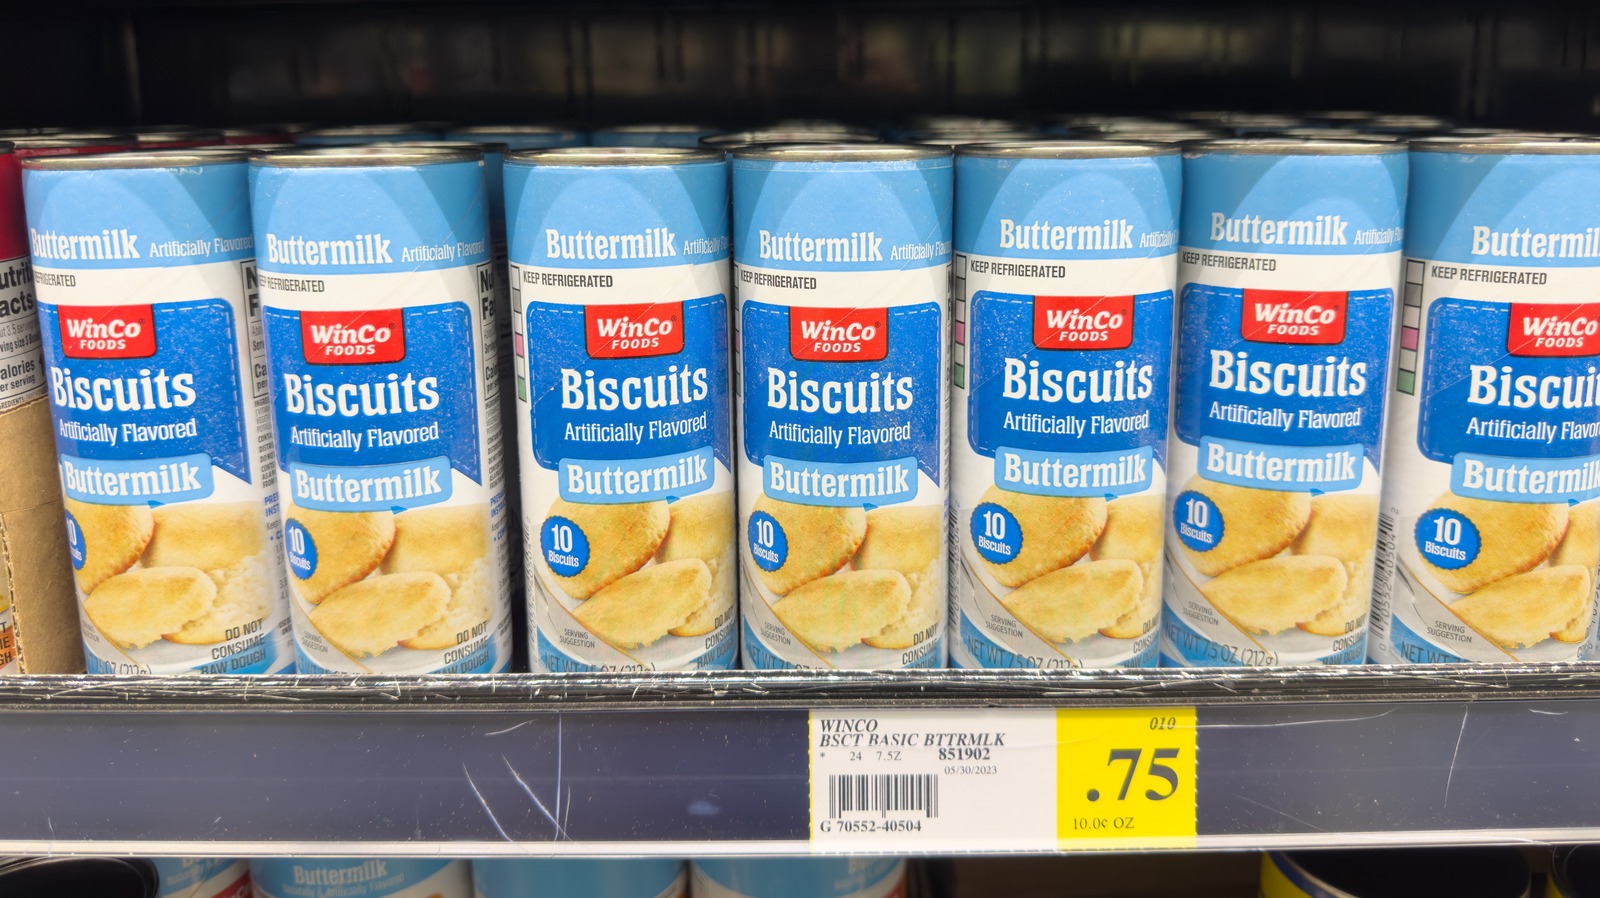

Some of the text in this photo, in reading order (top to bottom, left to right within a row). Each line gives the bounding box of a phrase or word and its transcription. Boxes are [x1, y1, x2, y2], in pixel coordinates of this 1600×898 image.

[1000, 219, 1134, 250] Buttermilk
[1139, 231, 1173, 248] Artificially
[1210, 212, 1348, 245] Buttermilk
[1354, 228, 1394, 246] Artificially
[31, 228, 253, 260] Buttermilk Artificially Flavored
[266, 233, 392, 266] Buttermilk
[401, 245, 455, 264] Artificially
[546, 227, 677, 260] Buttermilk
[683, 238, 720, 255] Artificially
[759, 230, 883, 263] Buttermilk
[890, 243, 934, 260] Artificially
[1471, 226, 1600, 259] Buttermil
[971, 260, 1066, 278] KEEP REFRIGERATED
[1182, 251, 1276, 271] KEEP REFRIGERATED
[267, 276, 325, 292] REFRIGERATED
[523, 271, 613, 288] KEEP REFRIGERATED
[740, 269, 817, 290] KEEP REFRIGERATED
[1431, 265, 1548, 285] KEEP REFRIGERATED
[0, 291, 34, 318] acts
[1255, 303, 1335, 324] WinCo
[67, 319, 141, 339] WinCo
[597, 316, 673, 339] WinCo
[1046, 309, 1123, 329] WinCo
[1522, 316, 1598, 337] WinCo
[311, 324, 391, 344] WinCo
[801, 320, 876, 341] WinCo
[1059, 331, 1108, 341] FOODS
[1267, 325, 1319, 336] FOODS
[80, 339, 127, 350] FOODS
[326, 344, 376, 356] FOODS
[611, 337, 659, 350] FOODS
[813, 342, 861, 353] FOODS
[1535, 337, 1584, 348] FOODS
[0, 358, 36, 379] alories
[1209, 350, 1367, 397] Biscuits
[51, 366, 197, 411] Biscuits
[561, 364, 708, 411] Biscuits
[767, 367, 914, 414] Biscuits
[1003, 358, 1153, 403] Biscuits
[1467, 364, 1600, 410] Biscuit
[284, 373, 439, 417] Biscuits
[1003, 410, 1149, 438] Artificially Flavored
[1209, 401, 1361, 431] Artificially Flavored
[60, 418, 197, 446] Artificially Flavored
[291, 421, 439, 452] Artificially Flavored
[564, 411, 707, 444] Artificially Flavored
[769, 421, 911, 448] Artificially Flavored
[1466, 416, 1600, 444] Artificially Flavor
[1004, 453, 1147, 488] Buttermilk
[1207, 443, 1356, 483] Buttermilk
[64, 461, 201, 496] Buttermilk
[295, 466, 442, 502] Buttermilk
[567, 454, 708, 495] Buttermilk
[770, 461, 910, 498] Buttermilk
[1186, 498, 1208, 527] 10
[756, 518, 774, 548] 10
[983, 510, 1005, 540] 10
[1180, 523, 1212, 544] Biscuits
[1434, 516, 1462, 545] 10
[288, 527, 305, 555] 10
[551, 523, 573, 552] 10
[978, 537, 1011, 555] Biscuits
[548, 550, 580, 568] Biscuits
[753, 543, 779, 563] Biscuits
[1424, 541, 1466, 561] Biscuits
[1182, 607, 1219, 626] SUGGESTION
[1188, 601, 1213, 616] SERVING
[225, 626, 240, 641] DO
[243, 618, 263, 636] NOT
[764, 622, 785, 635] SERVING
[985, 621, 1023, 638] SUGGESTION
[991, 614, 1016, 628] SERVING
[1434, 620, 1465, 634] SERVING
[457, 629, 469, 645] DO
[472, 620, 487, 638] NOT
[559, 635, 595, 649] SUGGESTION
[564, 628, 588, 639] SERVING
[760, 628, 791, 645] SUGGESTION
[914, 624, 937, 645] DO NOT
[1166, 621, 1182, 643] NET
[1183, 630, 1201, 653] WT
[1203, 639, 1219, 659] 7.5
[1221, 644, 1238, 664] OZ
[1427, 627, 1472, 644] SUGGESTION
[211, 633, 265, 660] CONSUME
[444, 635, 488, 664] CONSUME
[967, 635, 984, 658] NET
[987, 645, 1005, 666] WT
[1400, 641, 1424, 663] NET
[231, 648, 266, 671] DOUGH
[461, 650, 489, 673] DOUGH
[545, 651, 560, 672] NET
[820, 719, 878, 732] WINCO
[1150, 717, 1176, 730] 010
[820, 733, 1006, 747] BSCT BASIC BTTRMLK
[849, 747, 991, 761] 24 7.5Z 851902
[944, 765, 998, 775] 05/30/2023
[1086, 748, 1180, 801] .75
[820, 820, 922, 832] G 70552-40504
[1073, 817, 1134, 830] 10.0¢ OZ
[293, 859, 388, 885] Buttermilk
